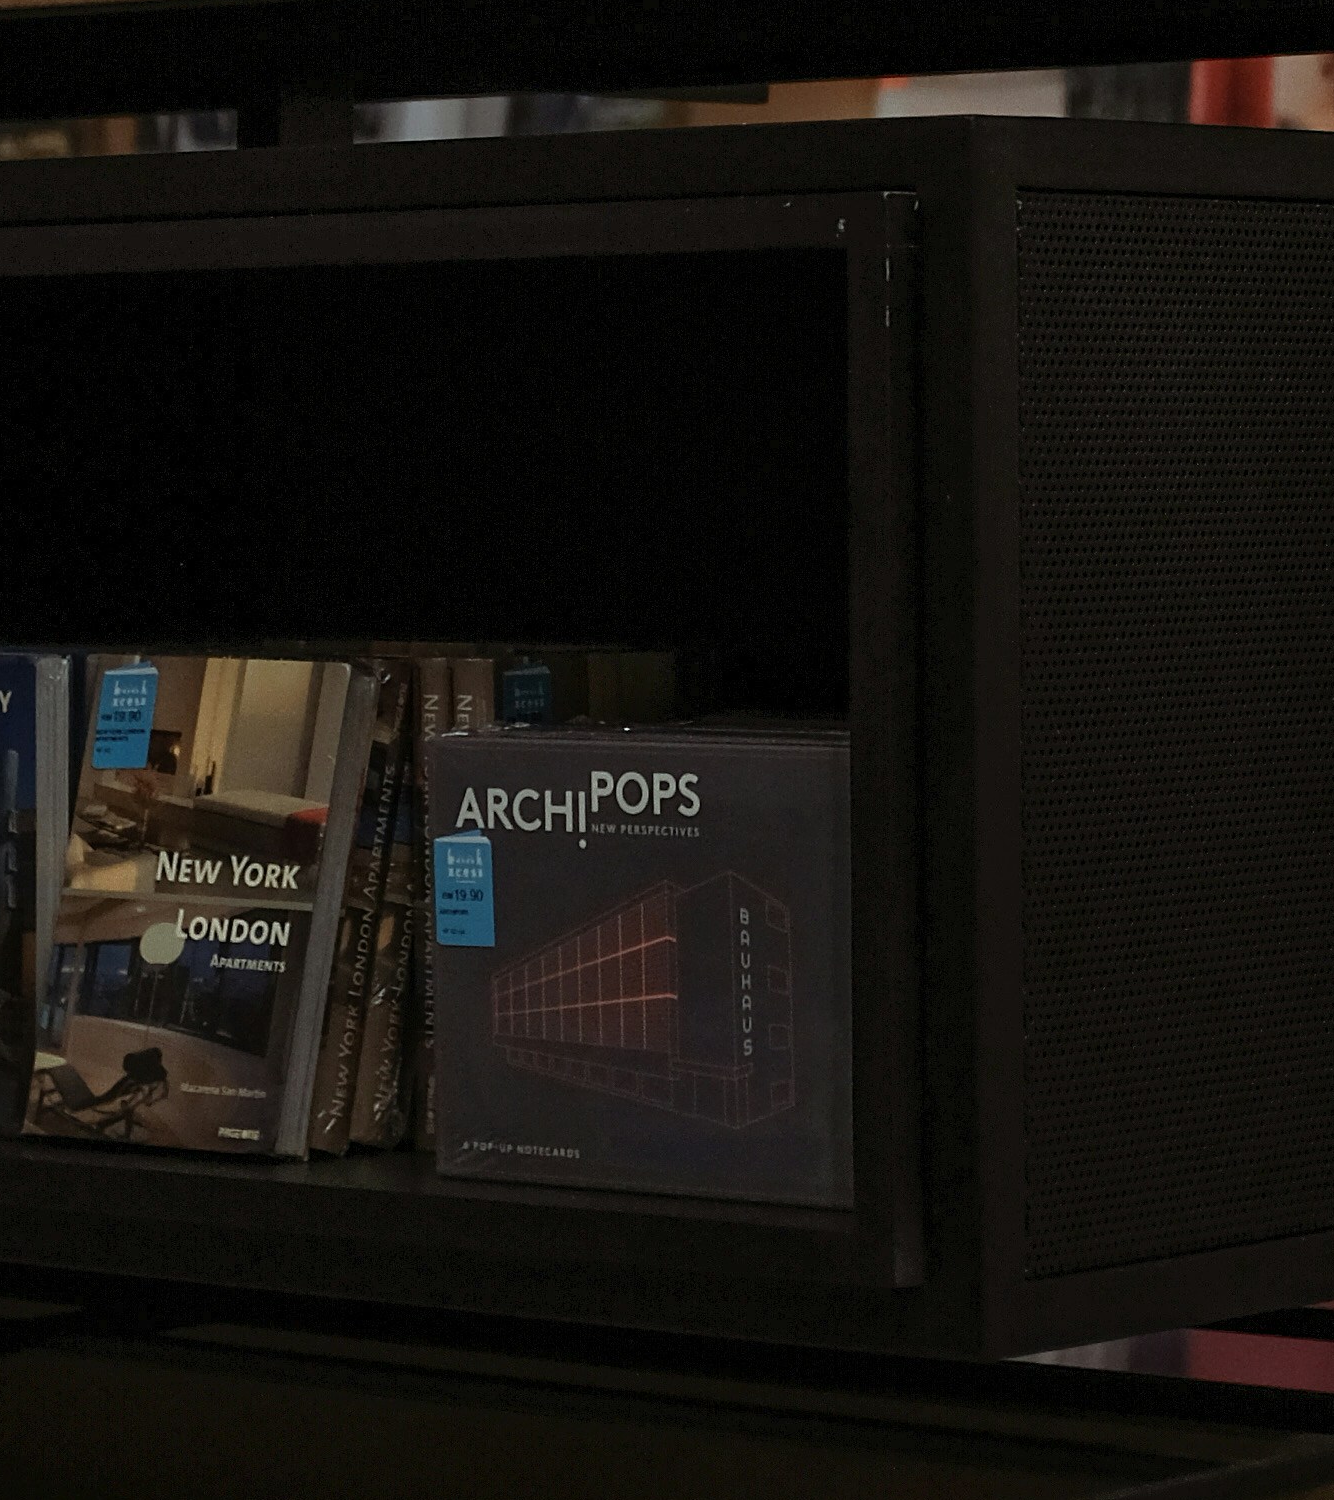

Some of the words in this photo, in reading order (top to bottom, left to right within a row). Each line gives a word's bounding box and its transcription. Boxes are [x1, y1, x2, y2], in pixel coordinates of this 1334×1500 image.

[363, 763, 396, 908] APARTMENTS
[591, 823, 616, 835] NEW
[620, 824, 701, 838] PERSPECTIVES
[156, 851, 222, 885] NEW
[230, 854, 302, 890] YORK
[175, 908, 291, 948] LONDON
[210, 953, 287, 975] APARTMENTS
[348, 909, 374, 999] LONDON
[739, 906, 754, 1057] BAUHAUS
[337, 1007, 360, 1059] YORK
[517, 1144, 580, 1159] NOTECARDS
